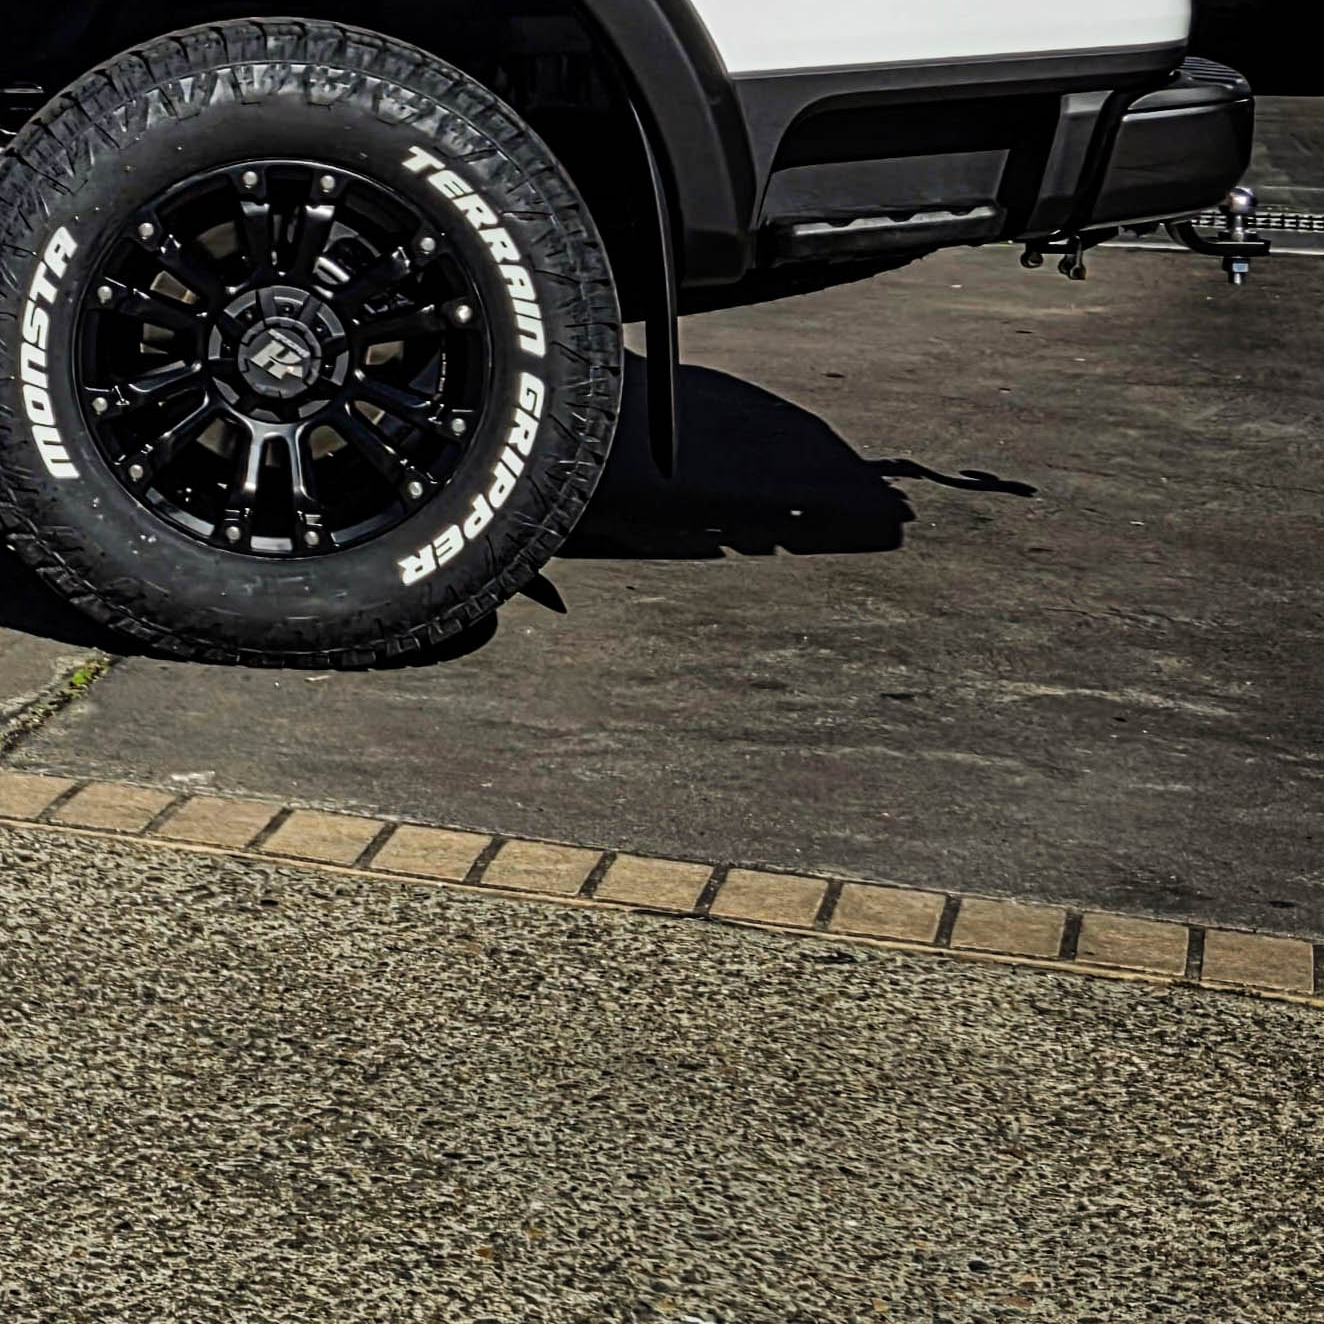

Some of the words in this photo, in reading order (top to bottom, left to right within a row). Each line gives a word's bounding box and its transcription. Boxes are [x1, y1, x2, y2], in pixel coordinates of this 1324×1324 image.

[17, 226, 78, 480] MONSTA
[402, 145, 547, 358] TERRAIN
[398, 370, 545, 587] GRIPPER
